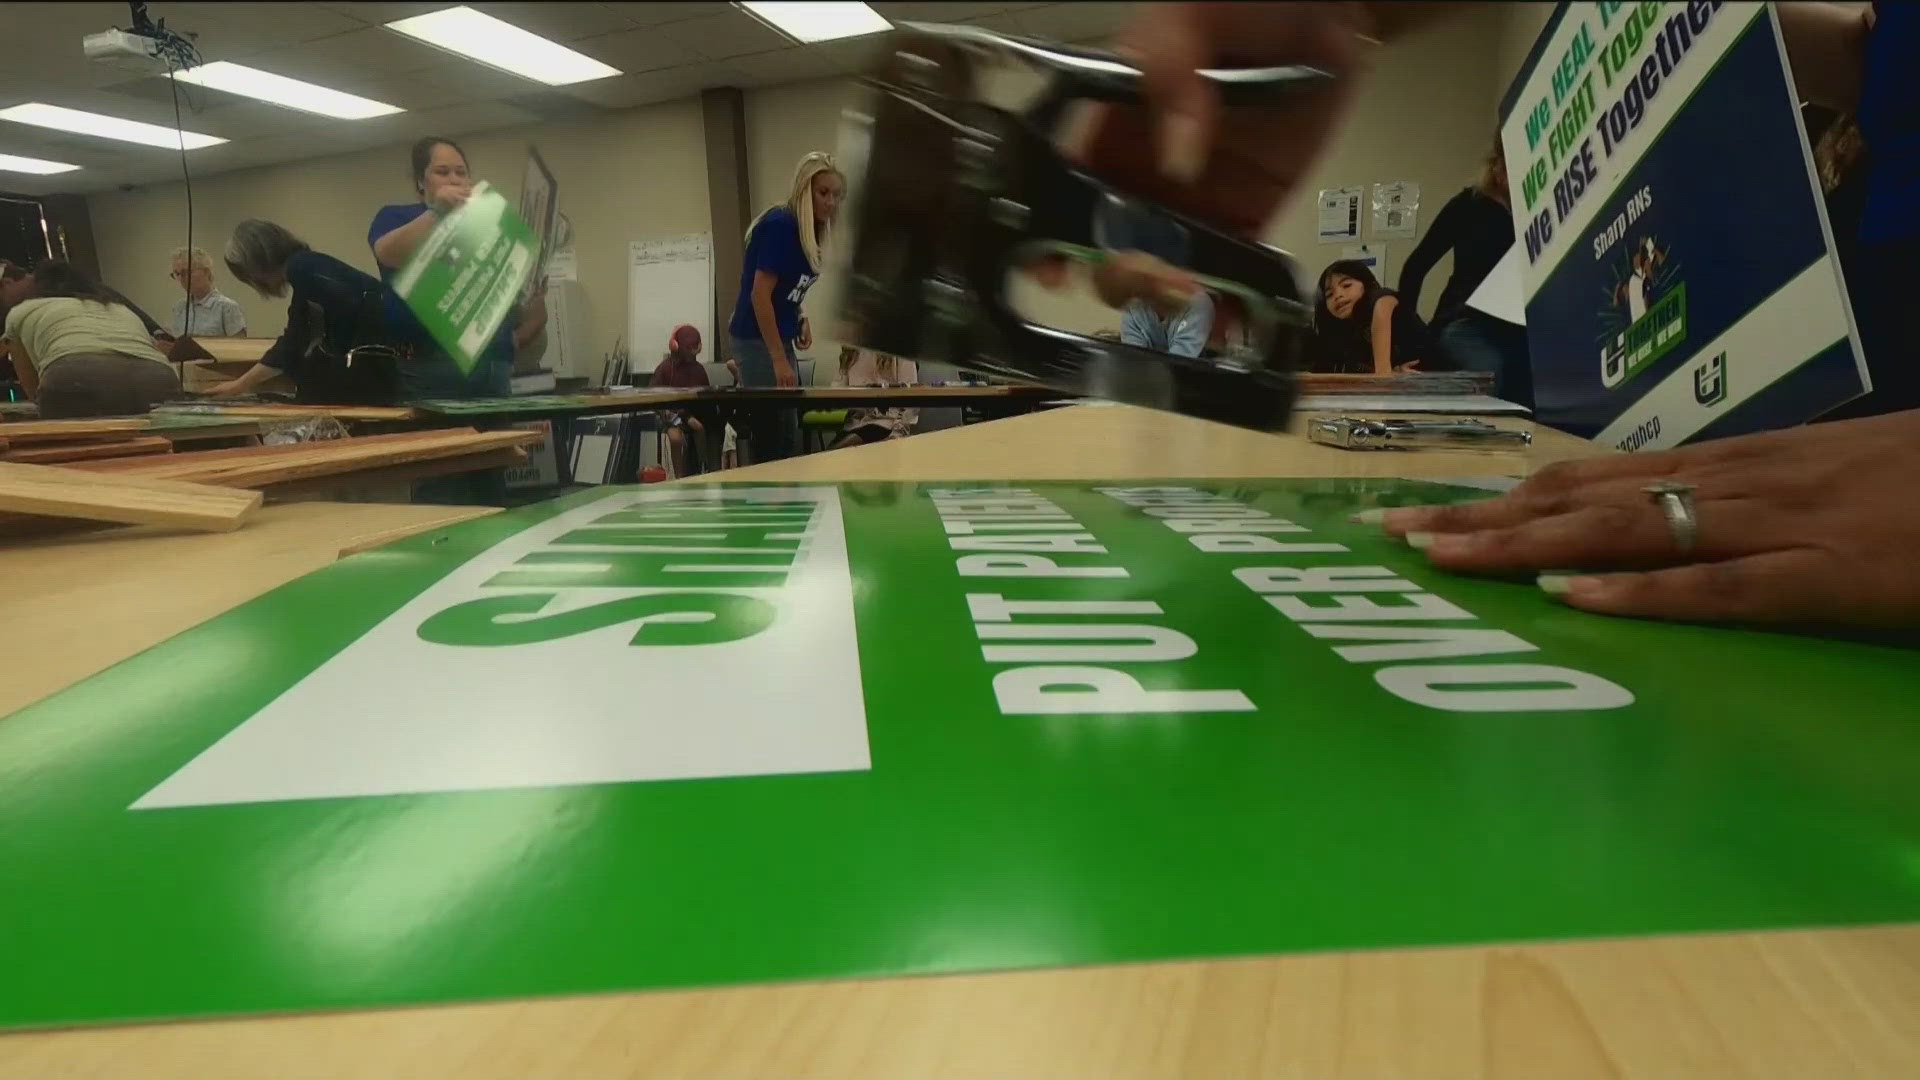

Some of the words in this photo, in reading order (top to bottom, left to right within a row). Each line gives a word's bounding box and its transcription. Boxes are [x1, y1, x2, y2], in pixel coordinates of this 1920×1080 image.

[1522, 157, 1547, 212] We
[1549, 72, 1597, 171] FIGHT
[1598, 2, 1666, 89] Toge
[1525, 97, 1550, 152] We
[1551, 22, 1596, 107] HEAL
[1524, 207, 1551, 265] We
[1553, 139, 1597, 225] RISE
[1593, 213, 1627, 260] Sharp
[1616, 415, 1661, 453] acuhcp
[416, 499, 817, 647] SHARP
[965, 592, 1258, 715] PUT
[1231, 565, 1637, 713] OVER
